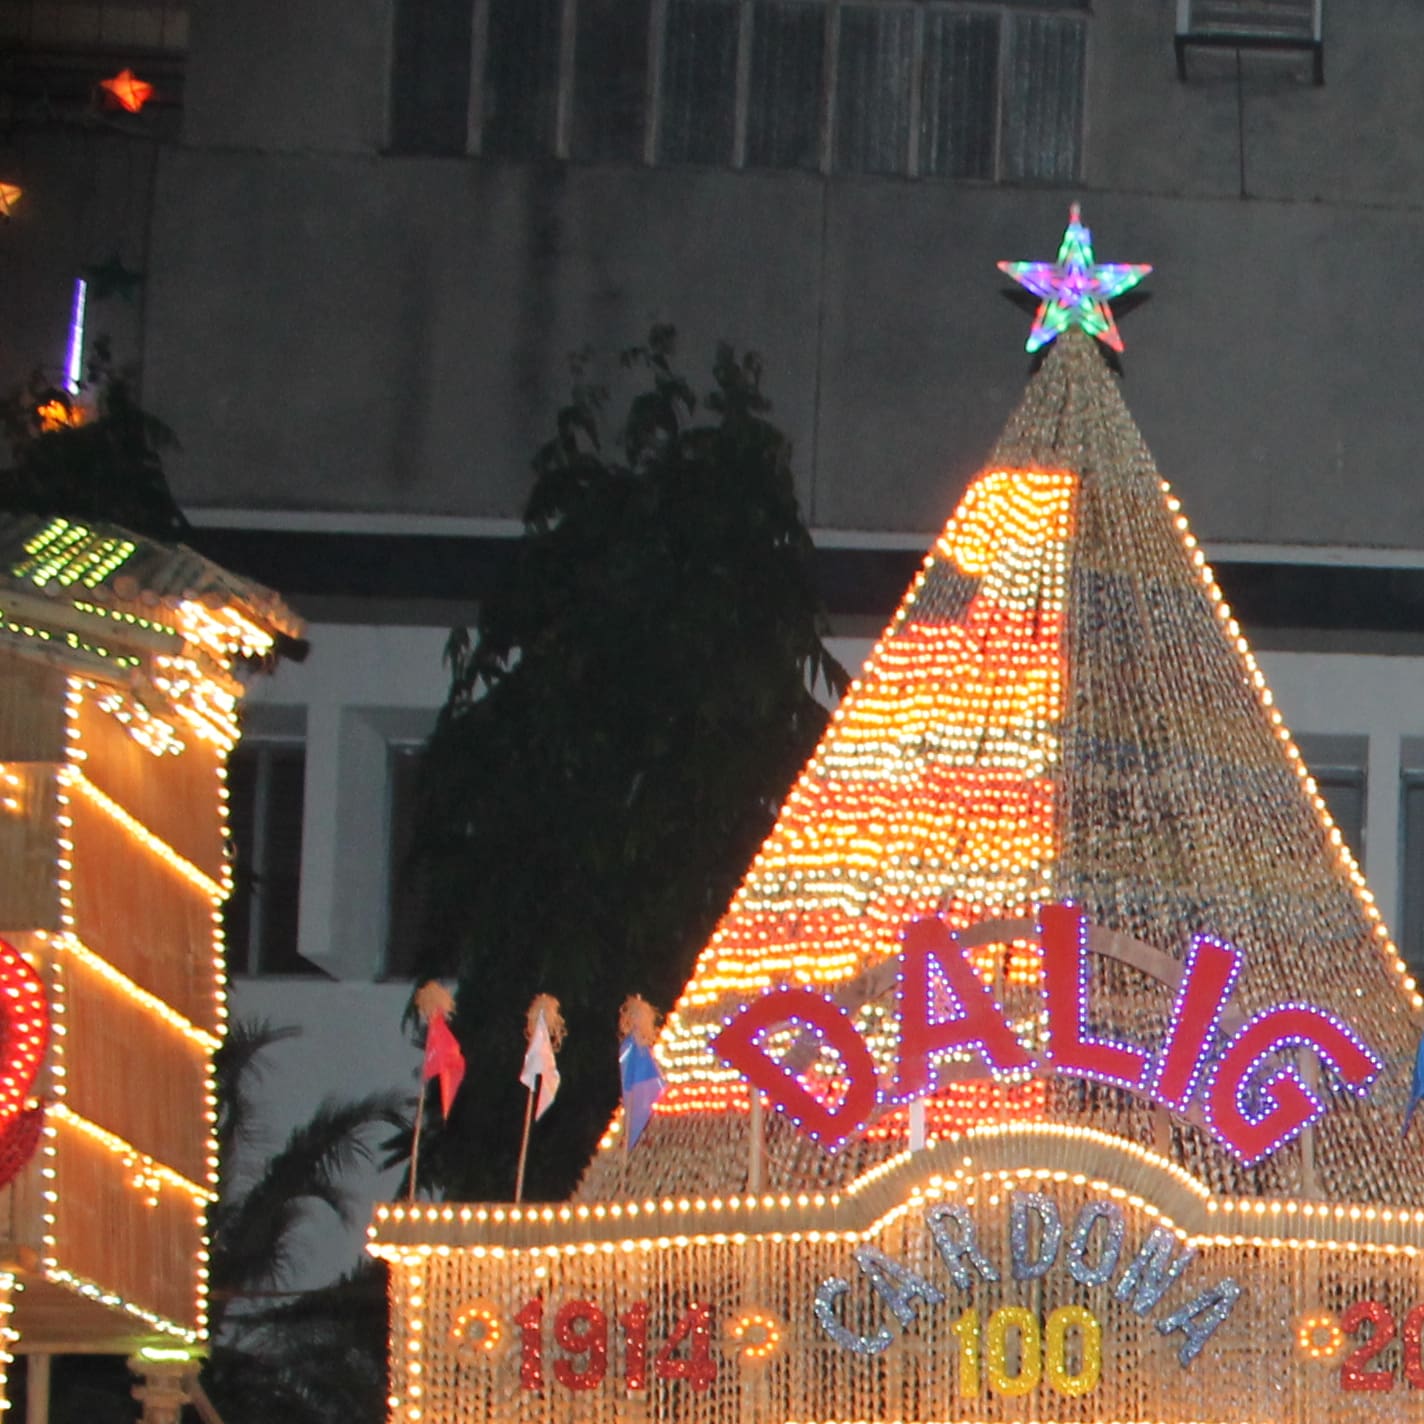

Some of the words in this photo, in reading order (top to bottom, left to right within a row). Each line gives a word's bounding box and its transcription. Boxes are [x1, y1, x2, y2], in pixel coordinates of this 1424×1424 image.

[708, 900, 1383, 1168] DALIG
[513, 1298, 717, 1391] 1914
[813, 1191, 1242, 1367] CARDONA
[950, 1304, 1102, 1398] 100
